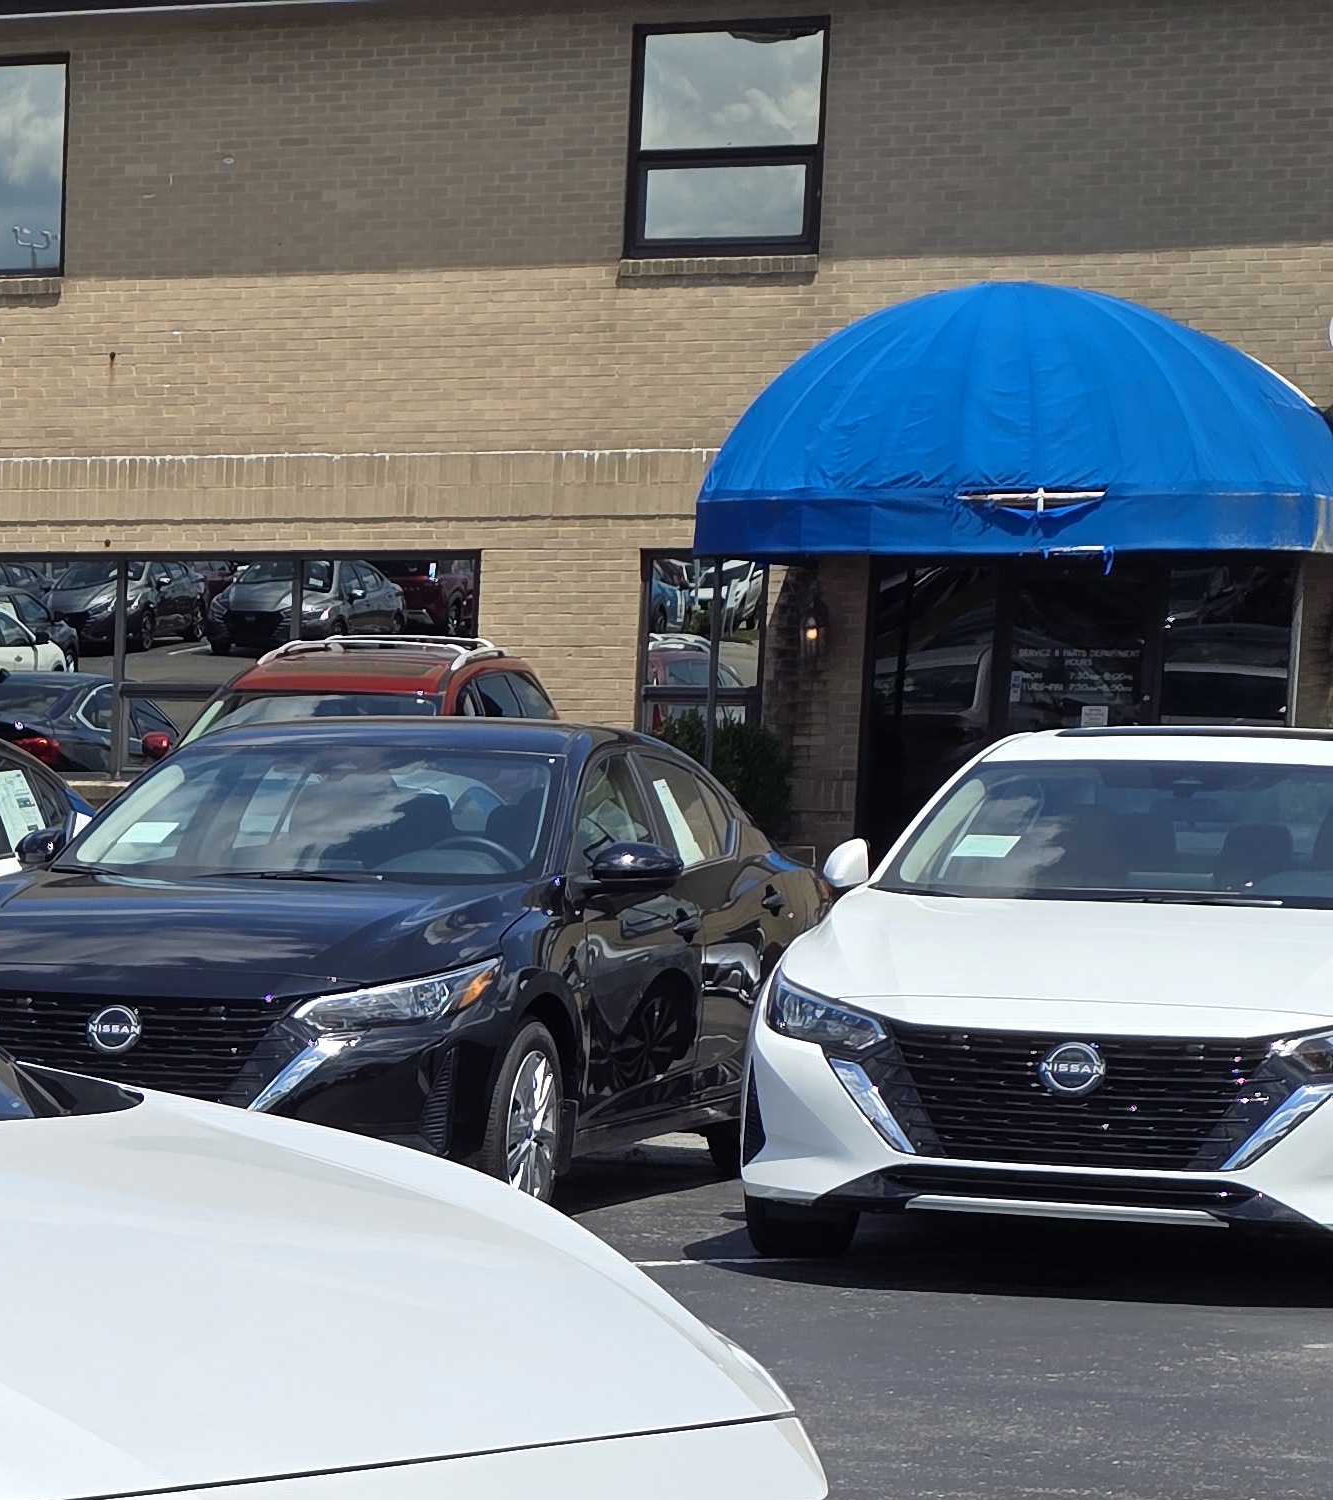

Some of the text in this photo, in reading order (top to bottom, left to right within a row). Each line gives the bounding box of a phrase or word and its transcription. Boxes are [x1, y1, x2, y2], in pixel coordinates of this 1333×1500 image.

[1018, 648, 1052, 657] SERVICE
[88, 1022, 141, 1035] NISSAN
[1041, 1061, 1106, 1075] NISSAN
